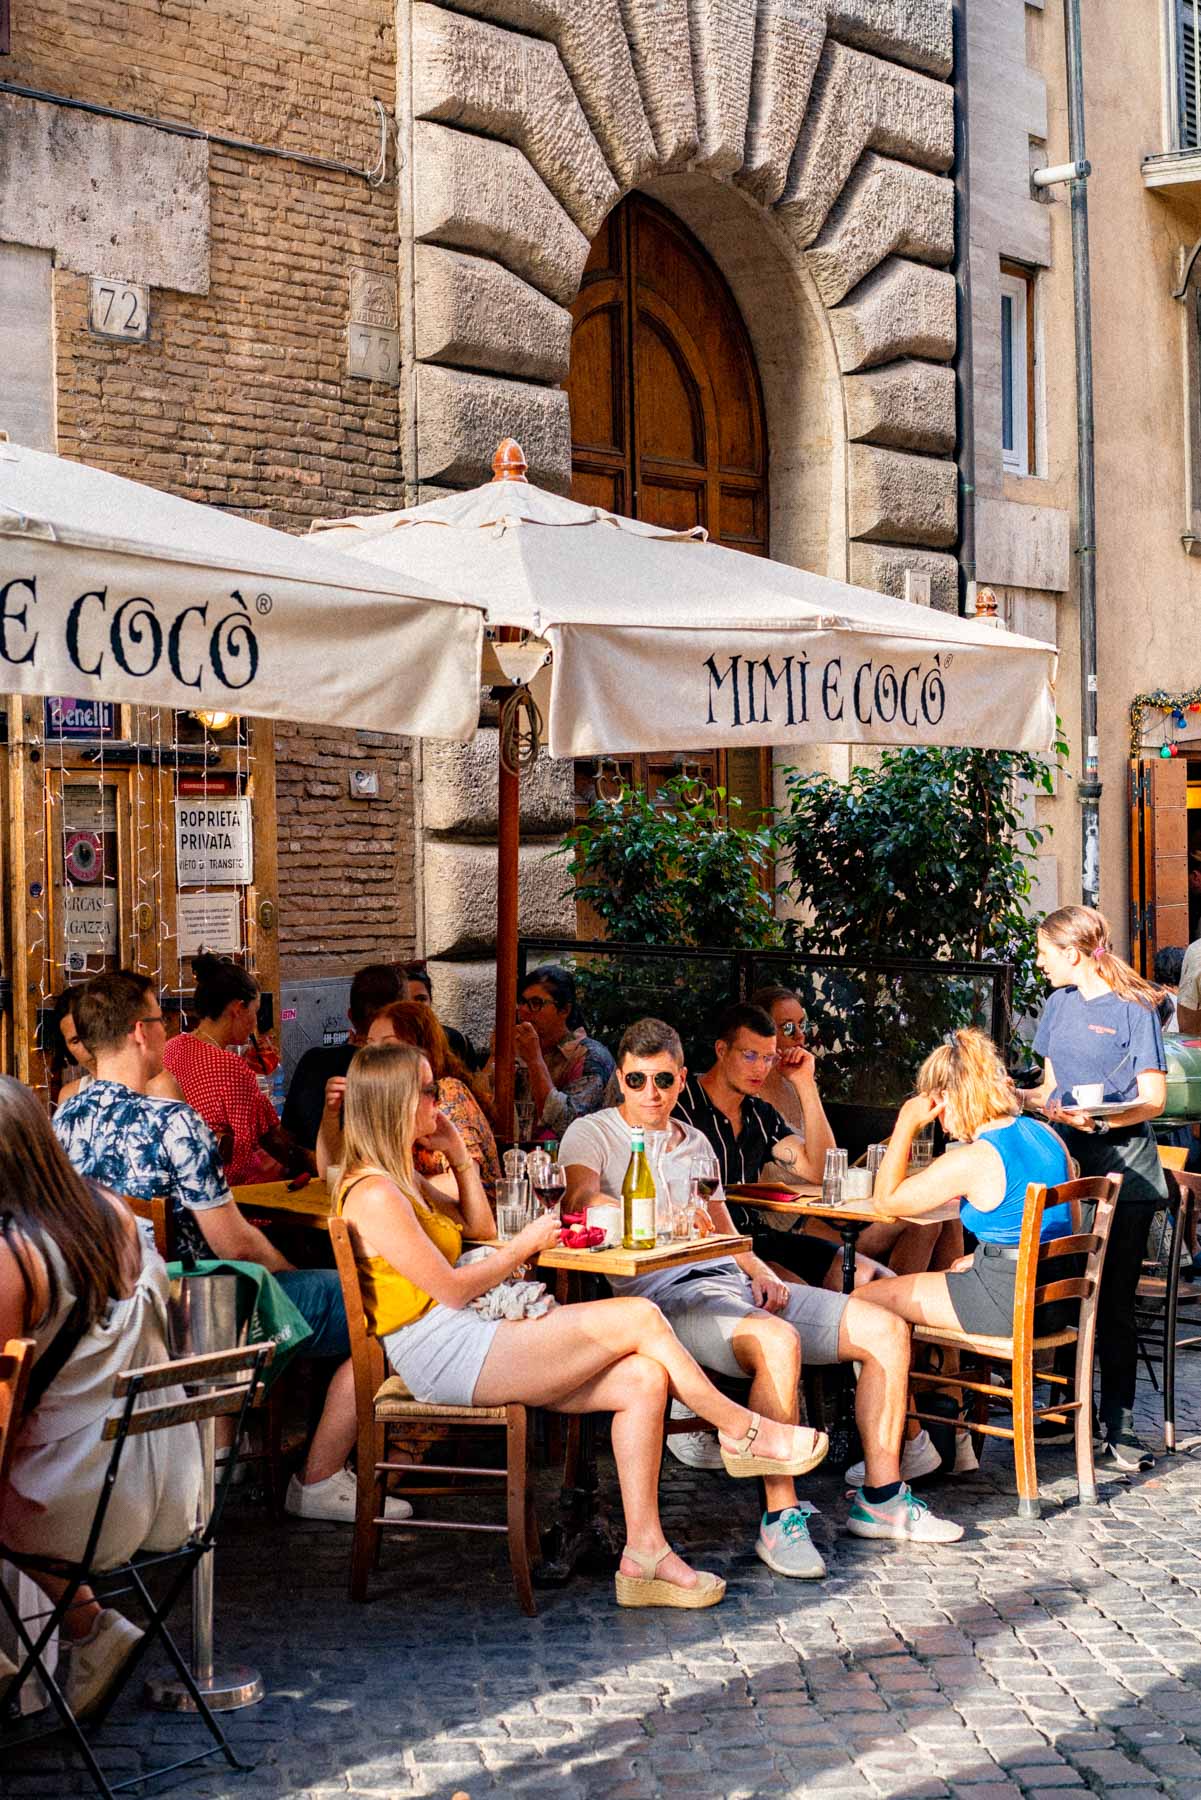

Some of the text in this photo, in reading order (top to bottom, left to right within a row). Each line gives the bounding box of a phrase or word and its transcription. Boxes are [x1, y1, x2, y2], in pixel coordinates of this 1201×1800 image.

[99, 287, 140, 330] 72
[359, 333, 391, 373] 73
[0, 576, 38, 666] E
[702, 651, 811, 727] MIMÌ
[822, 656, 844, 722] E
[50, 697, 109, 727] Benelli
[181, 833, 232, 850] PRIVATA
